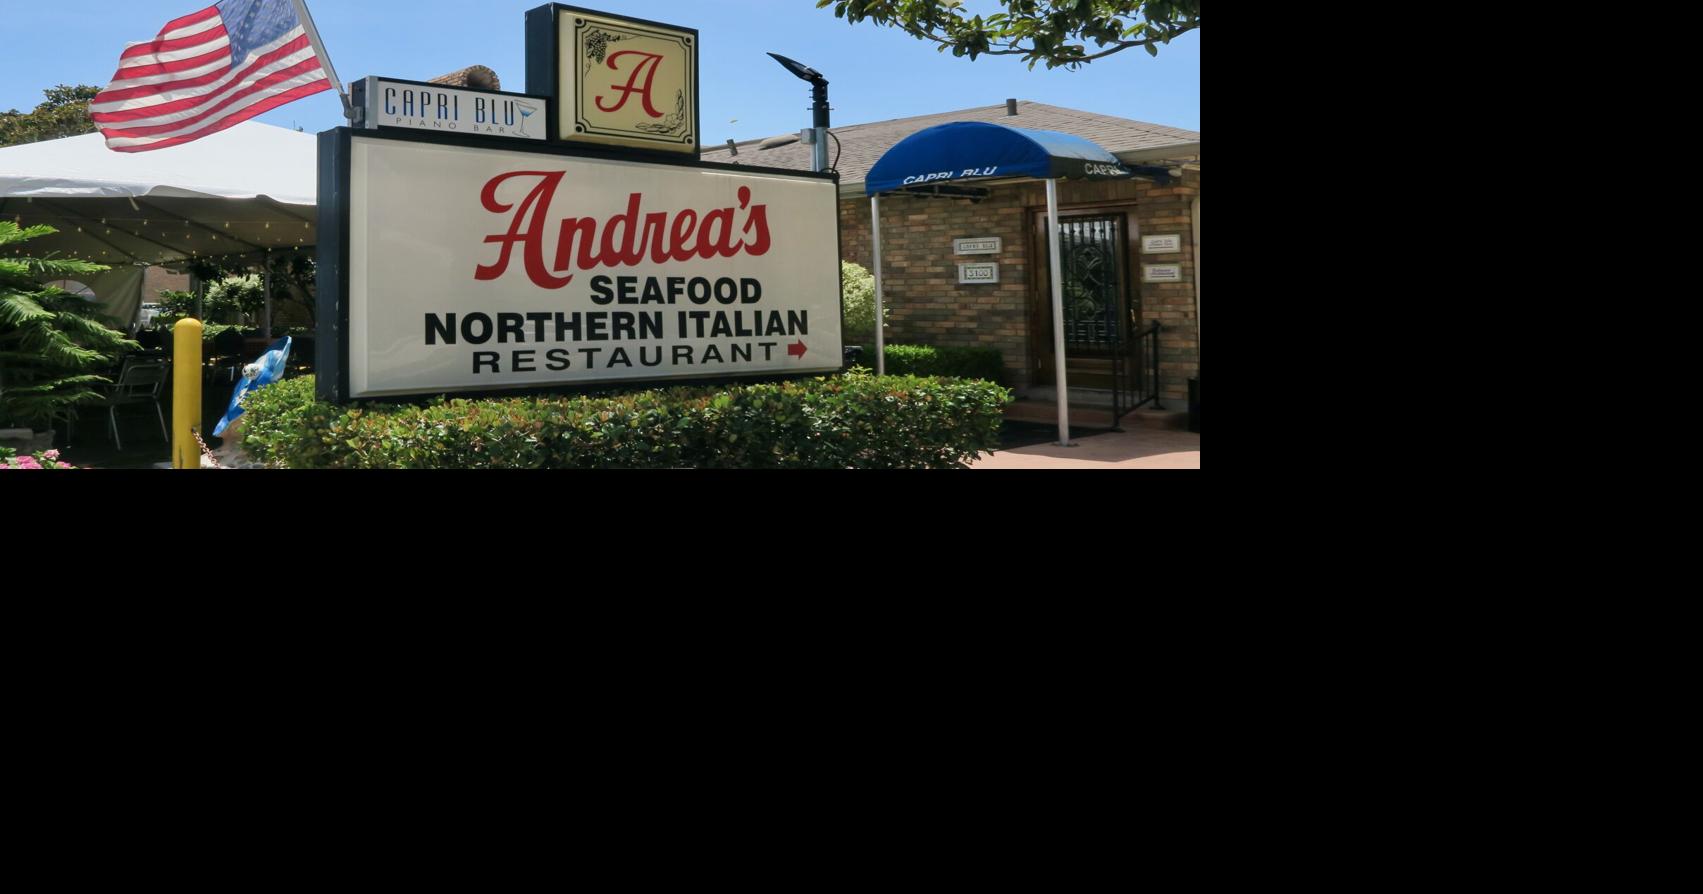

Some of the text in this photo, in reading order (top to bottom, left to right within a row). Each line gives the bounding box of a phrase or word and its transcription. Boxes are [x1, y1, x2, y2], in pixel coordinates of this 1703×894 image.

[595, 50, 664, 118] A
[385, 87, 514, 126] CAPRI BLU
[396, 117, 505, 134] PIANO BAR
[903, 170, 954, 185] CAPRI
[474, 170, 771, 290] Andrea's
[590, 276, 762, 305] SEAFOOD
[424, 310, 808, 345] NORTHERN ITALIAN
[472, 342, 778, 374] RESTAURANT
